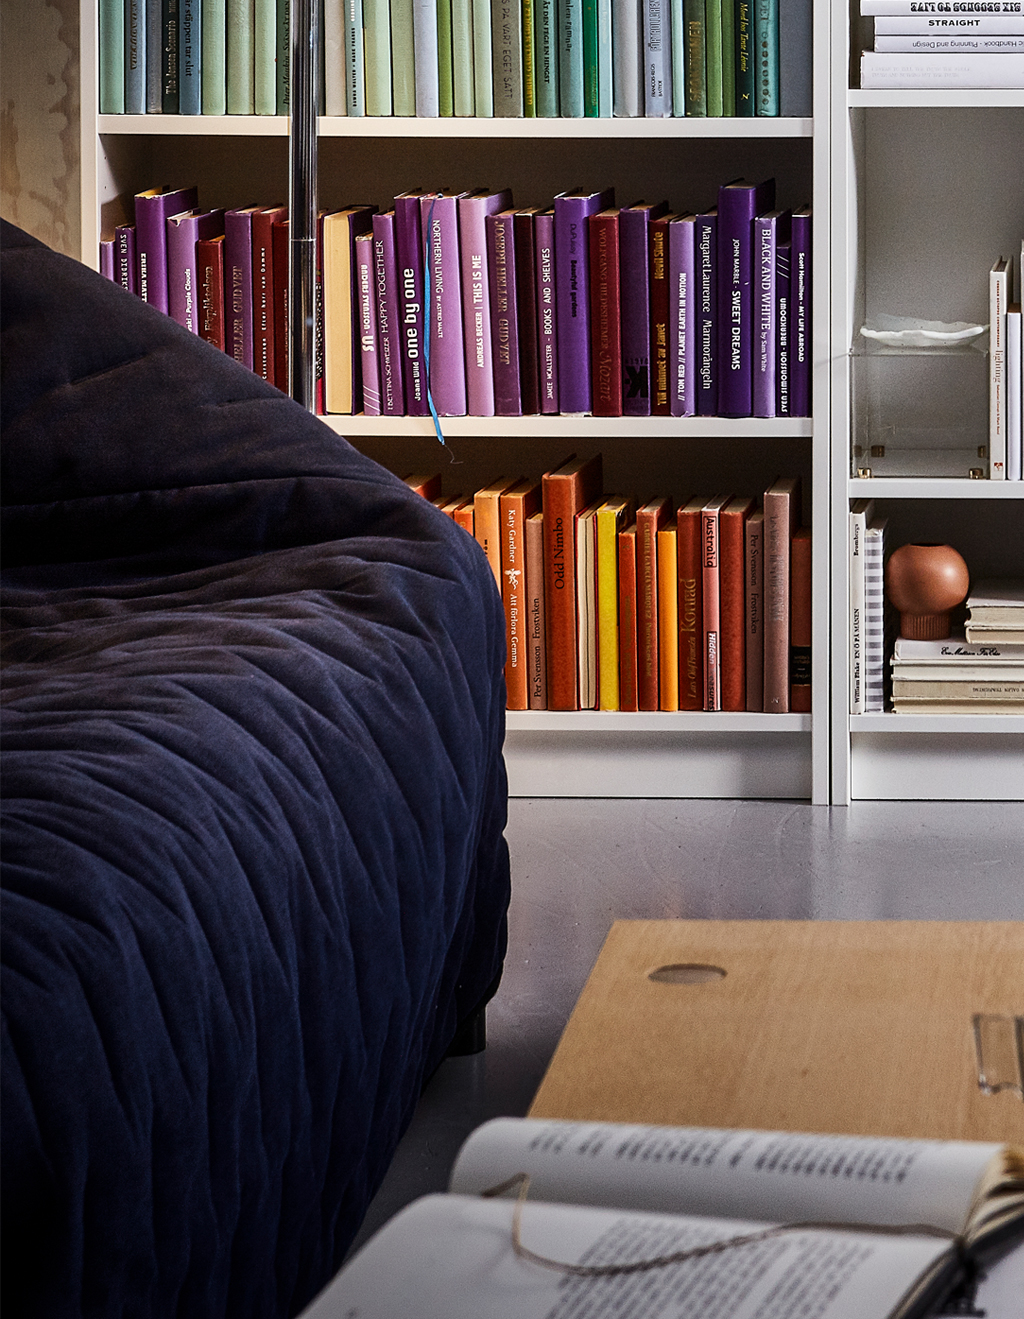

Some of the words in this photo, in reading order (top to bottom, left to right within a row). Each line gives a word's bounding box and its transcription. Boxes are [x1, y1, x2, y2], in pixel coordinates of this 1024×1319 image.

[910, 2, 936, 12] LIVE
[938, 2, 951, 12] TO
[954, 2, 1000, 12] SECONDS
[1003, 2, 1021, 12] SIX
[183, 9, 194, 44] stäppen
[544, 46, 550, 55] EN
[912, 40, 935, 48] Design
[951, 40, 978, 48] Planning
[185, 60, 194, 76] slut
[700, 226, 712, 267] Margaret
[761, 229, 771, 263] BLACK
[472, 255, 482, 268] ME
[360, 264, 368, 293] ANDERS
[402, 269, 415, 299] one
[473, 271, 482, 280] IS
[761, 266, 771, 290] AND
[473, 283, 483, 303] THIS
[702, 269, 712, 312] Laurence
[362, 295, 370, 329] SVENSSON
[404, 303, 420, 324] by
[732, 291, 741, 324] SWEET
[761, 292, 771, 330] WHITE
[799, 306, 804, 317] MY
[475, 312, 483, 336] BECKER
[362, 336, 374, 351] US
[407, 328, 418, 358] one
[476, 338, 484, 368] ANDREAS
[700, 320, 713, 389] Marmorängeln
[732, 327, 741, 370] DREAMS
[780, 396, 788, 413] SVEN
[508, 509, 516, 528] Katy
[553, 518, 564, 559] Nimbo
[706, 518, 716, 567] Australia
[554, 563, 564, 590] Odd
[510, 594, 518, 606] Att
[680, 578, 696, 632] Konrad
[751, 593, 759, 634] Frostviken
[510, 608, 518, 635] förlora
[532, 598, 540, 639] Frostviken
[533, 646, 541, 682] Svensson
[854, 650, 860, 658] EN
